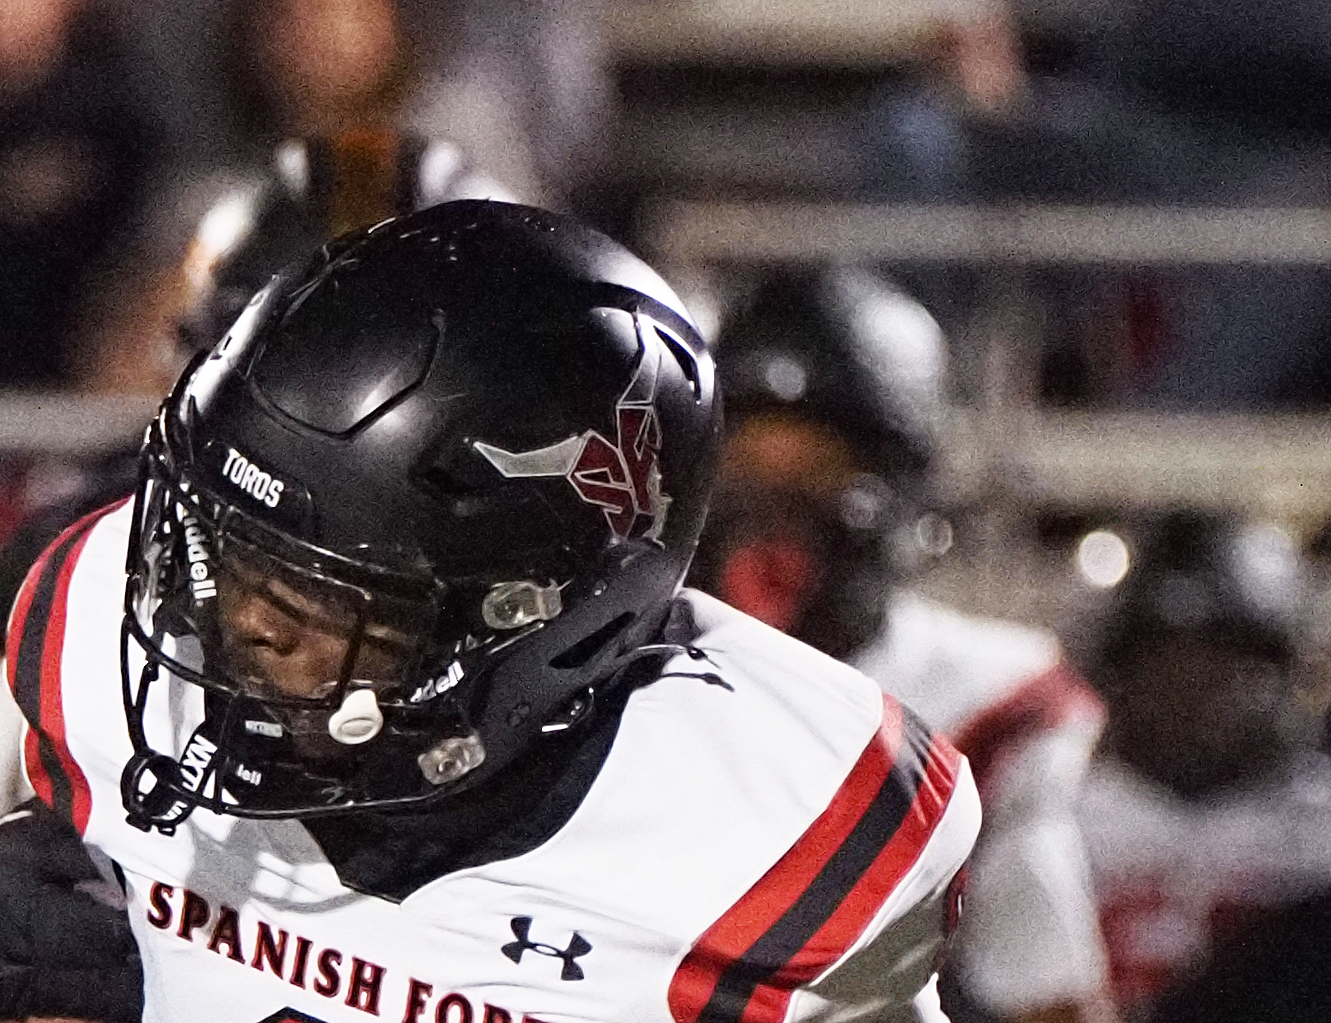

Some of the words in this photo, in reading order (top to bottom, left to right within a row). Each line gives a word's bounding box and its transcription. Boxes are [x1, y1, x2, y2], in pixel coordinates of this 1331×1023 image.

[222, 448, 285, 508] TOROS
[183, 516, 218, 600] iddell
[146, 880, 389, 1017] SPANISH
